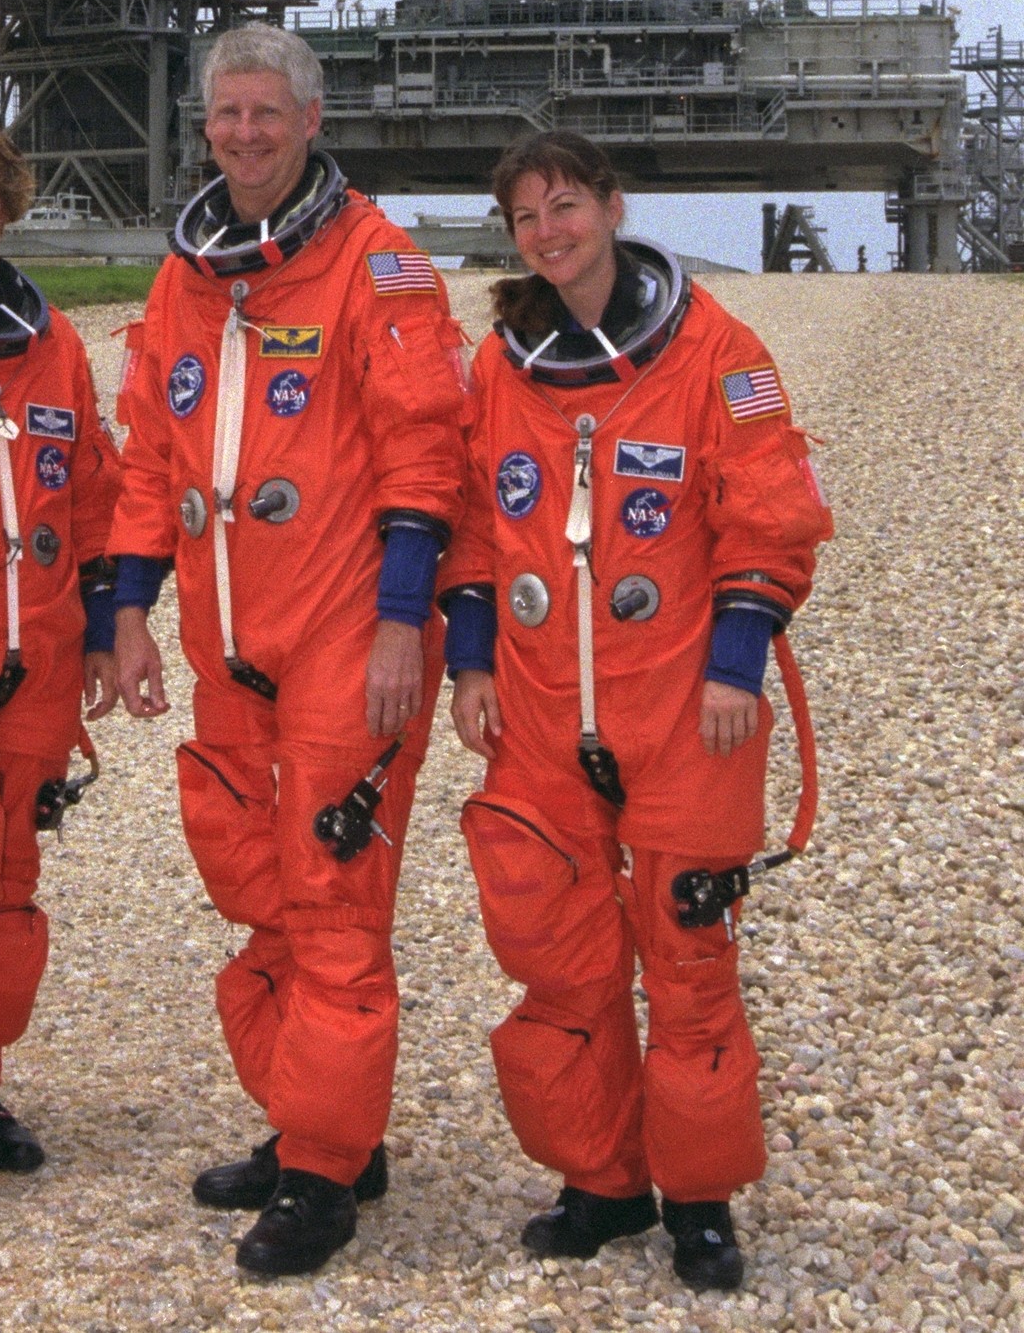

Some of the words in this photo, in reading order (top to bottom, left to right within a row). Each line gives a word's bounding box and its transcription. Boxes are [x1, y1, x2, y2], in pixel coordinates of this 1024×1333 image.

[273, 389, 306, 402] NASA
[39, 462, 67, 476] NASA
[627, 507, 666, 523] NASA
